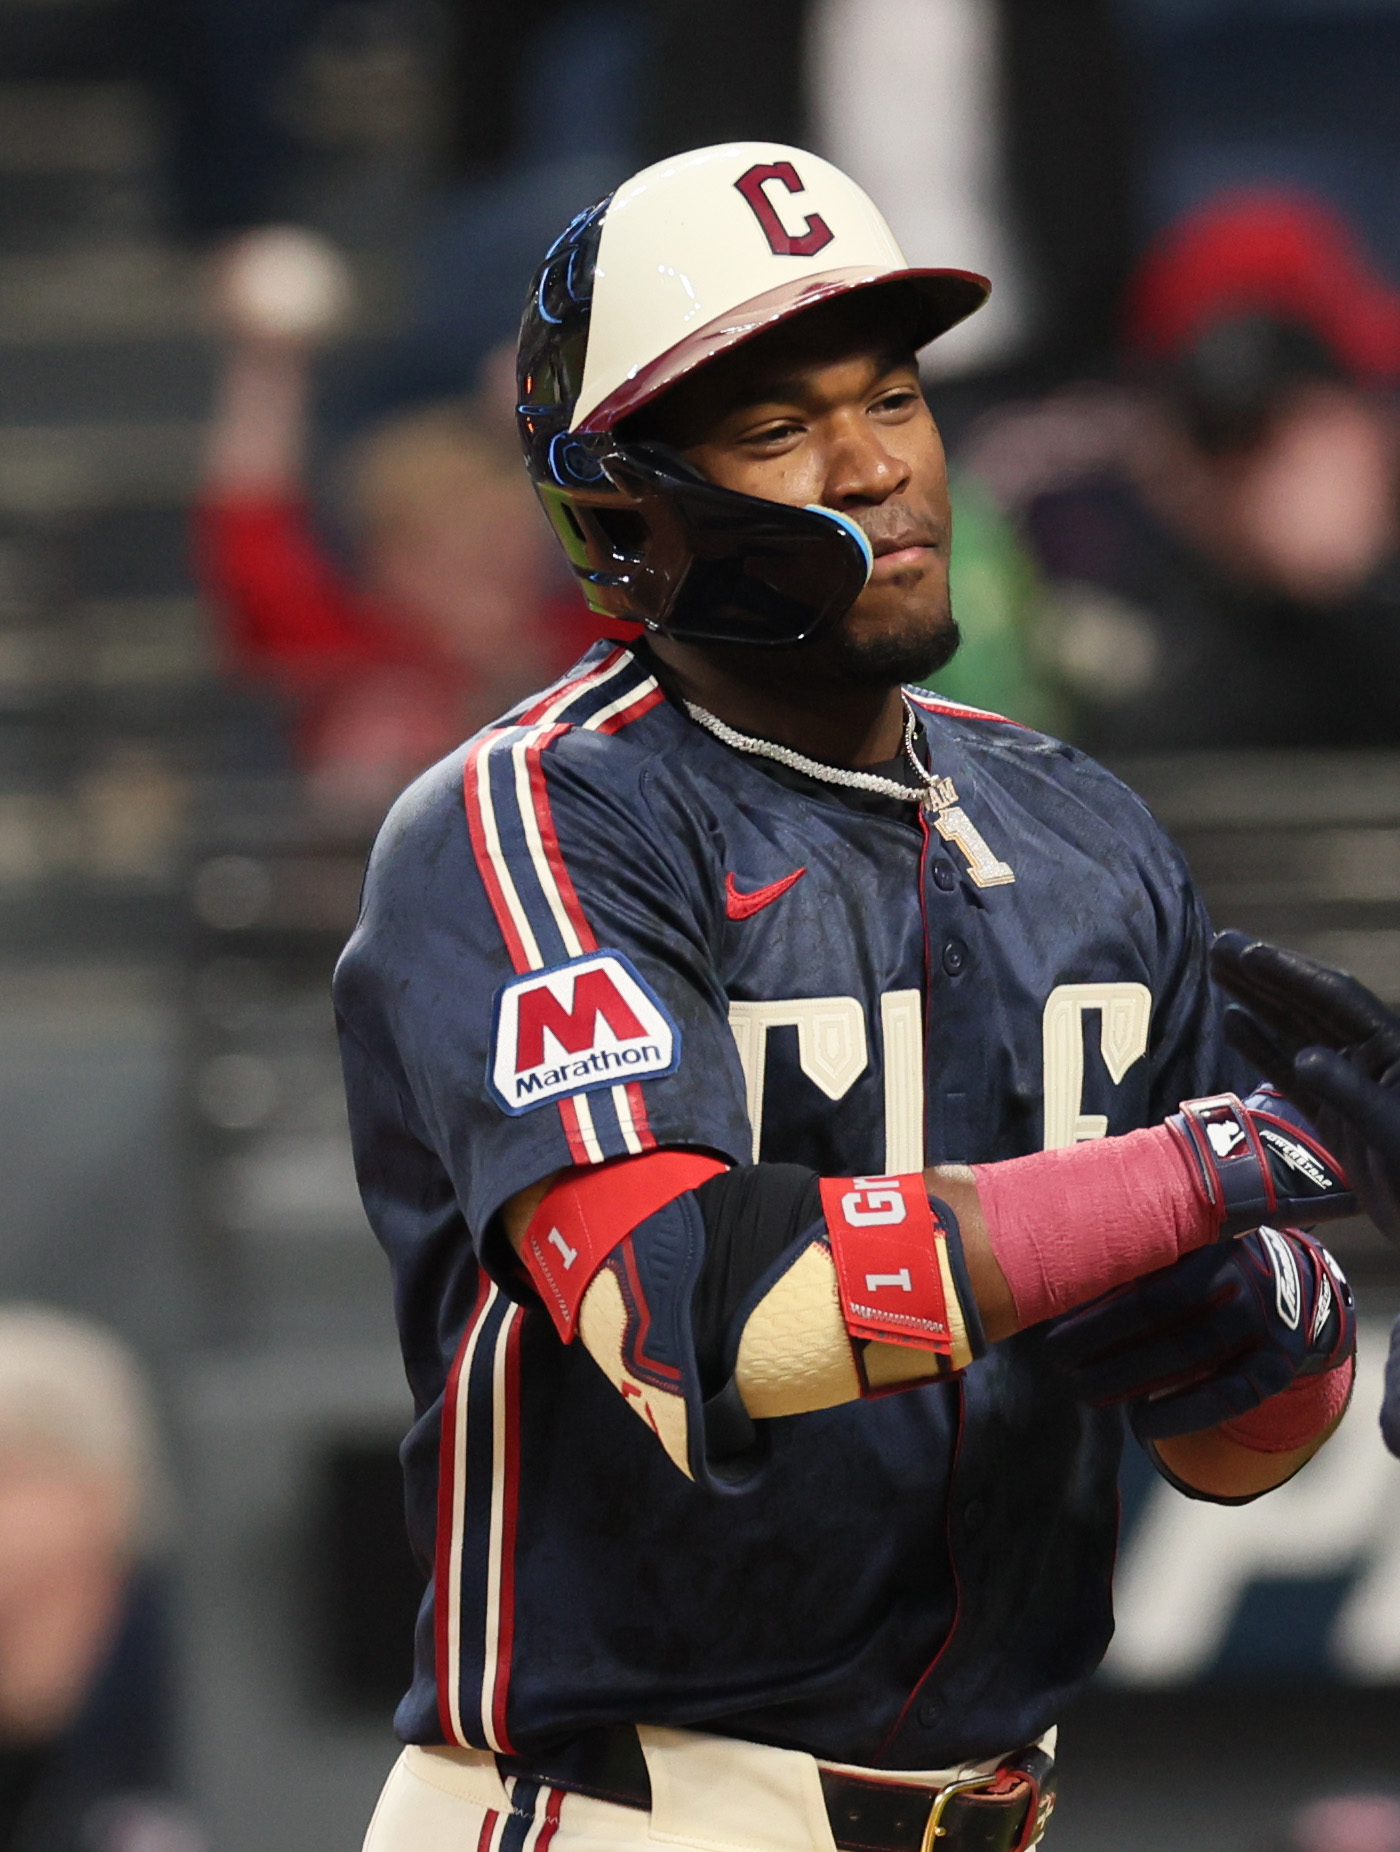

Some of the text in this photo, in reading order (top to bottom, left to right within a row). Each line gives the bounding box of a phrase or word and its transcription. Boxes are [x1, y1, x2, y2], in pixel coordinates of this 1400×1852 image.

[733, 161, 834, 257] C
[934, 806, 1015, 888] 1
[515, 968, 650, 1074] M
[515, 1045, 662, 1098] Marathon
[1259, 1129, 1333, 1189] POWERSTRAP
[547, 1226, 578, 1271] 1
[865, 1268, 912, 1292] 1
